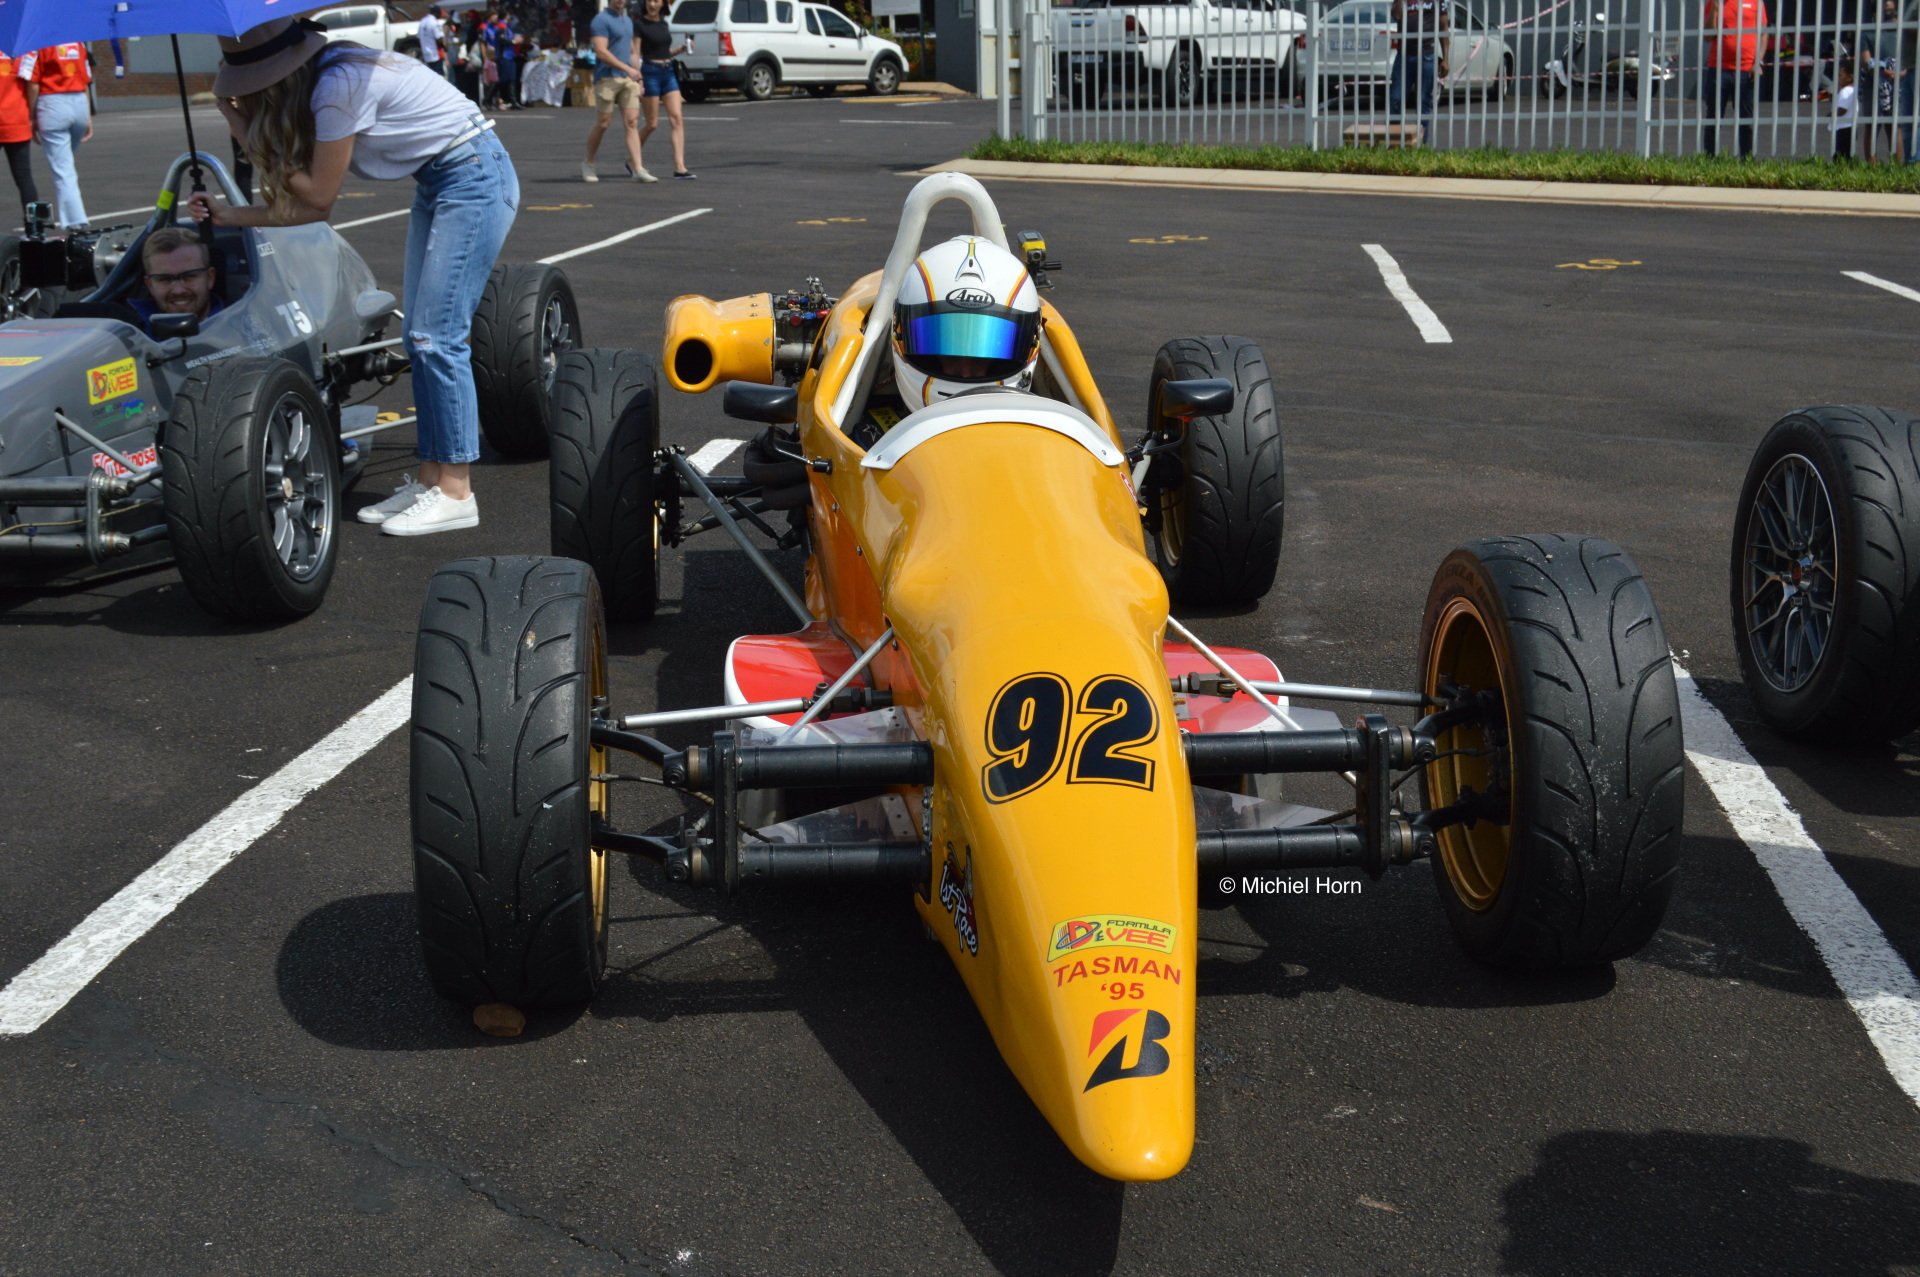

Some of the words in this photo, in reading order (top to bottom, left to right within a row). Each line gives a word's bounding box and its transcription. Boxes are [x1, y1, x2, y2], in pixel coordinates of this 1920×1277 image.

[954, 289, 991, 304] Arai
[275, 300, 313, 338] 75
[110, 371, 136, 393] VEE
[981, 671, 1161, 805] 92
[1105, 928, 1169, 948] VEE
[1106, 919, 1172, 935] FORMULA
[1053, 956, 1181, 988] TASMAN
